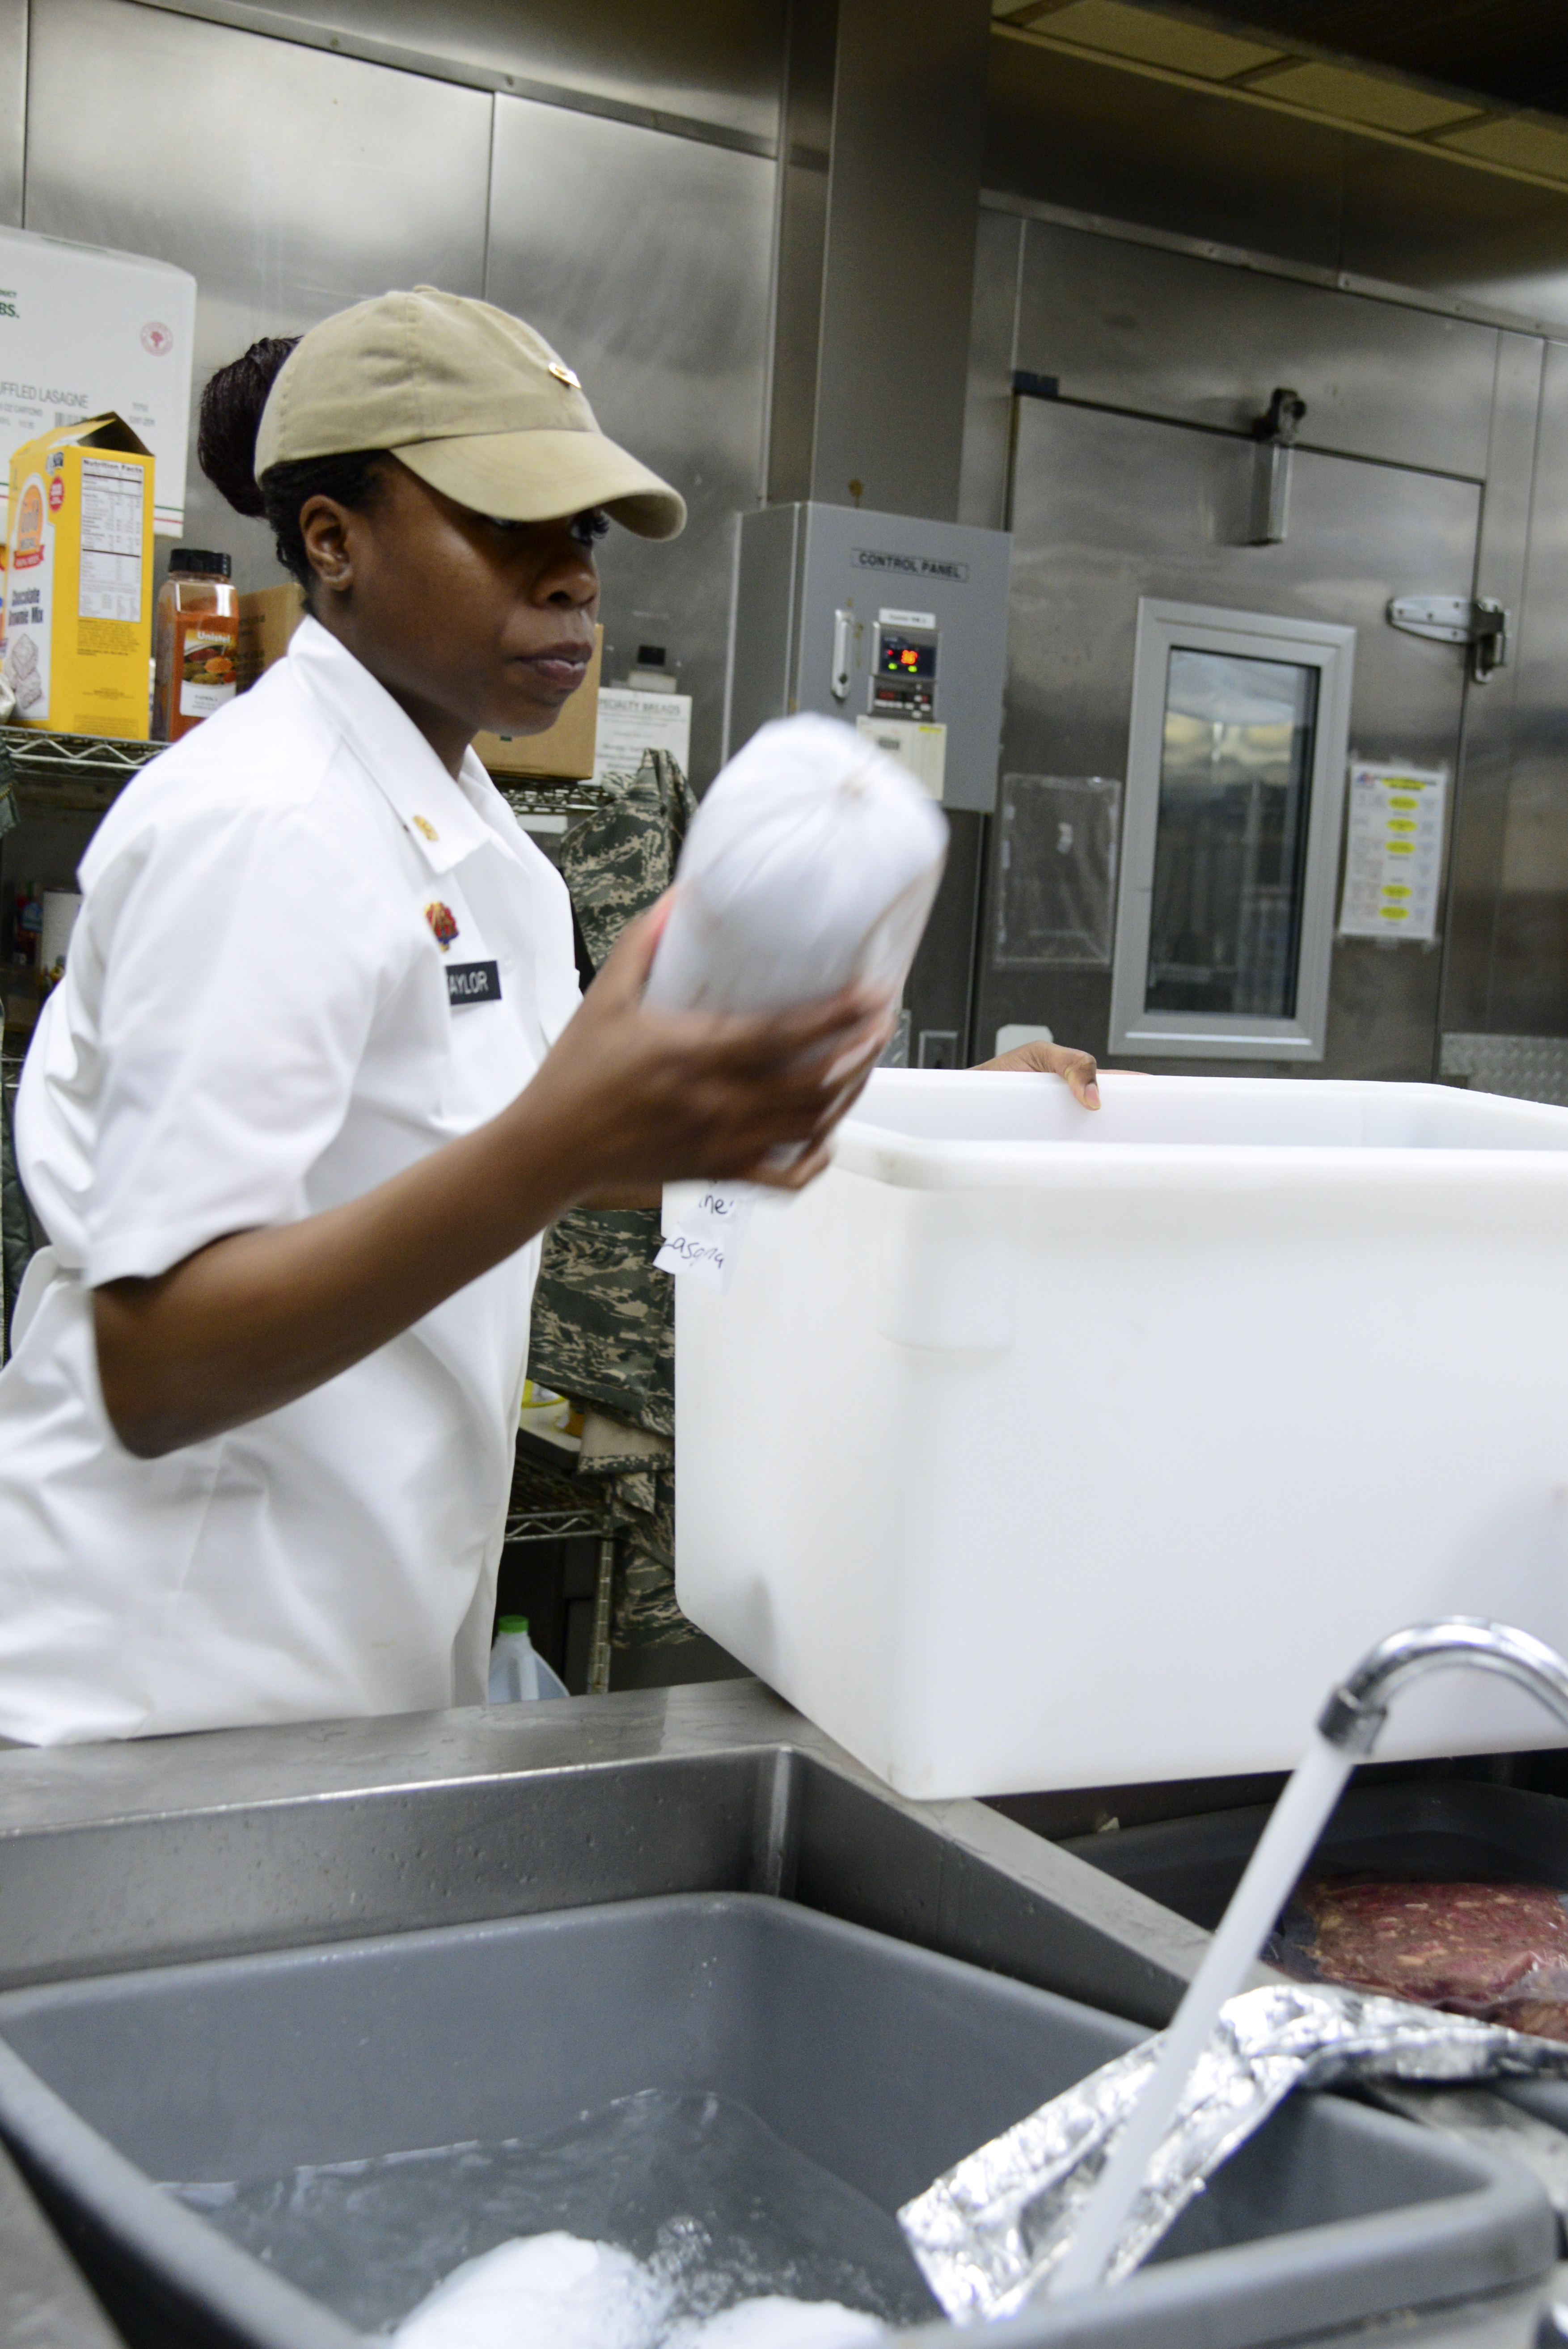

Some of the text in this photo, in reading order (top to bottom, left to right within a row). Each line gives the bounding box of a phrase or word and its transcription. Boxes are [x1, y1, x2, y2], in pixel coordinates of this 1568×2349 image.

[0, 382, 89, 409] FFLED LASAGNE
[84, 460, 143, 473] Nutrition Facts
[859, 552, 961, 578] CONTROL PANEL
[448, 970, 489, 995] AYLOR
